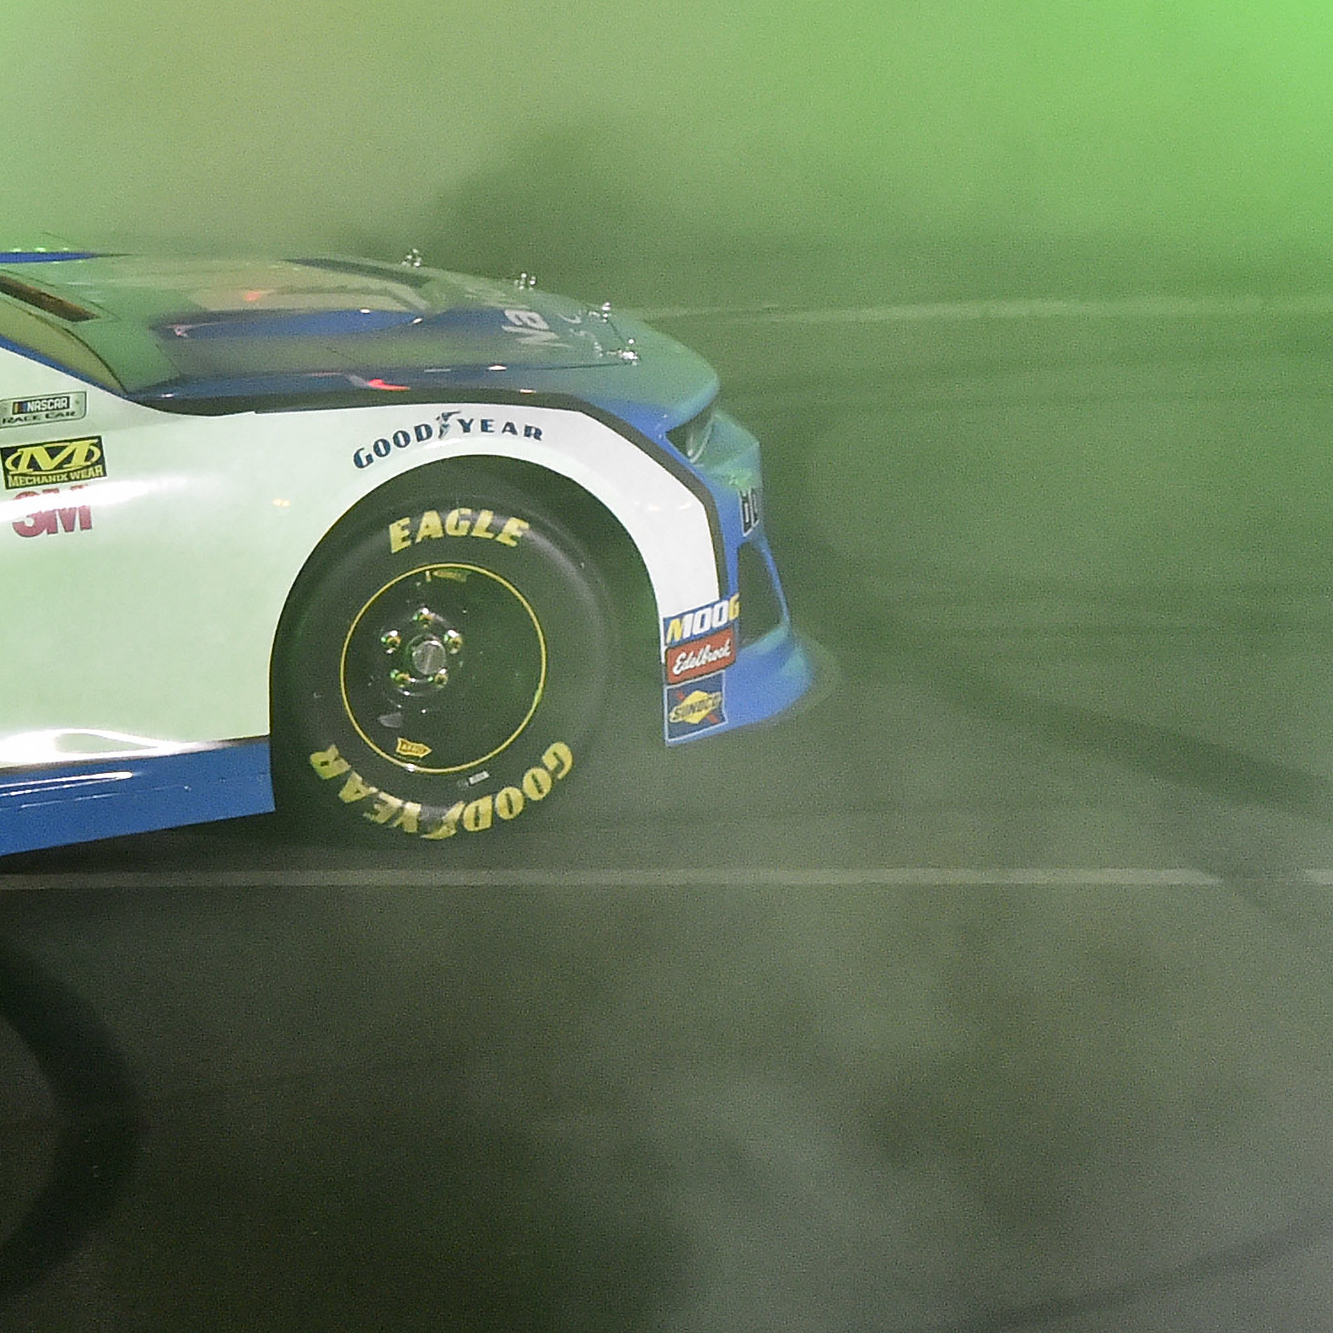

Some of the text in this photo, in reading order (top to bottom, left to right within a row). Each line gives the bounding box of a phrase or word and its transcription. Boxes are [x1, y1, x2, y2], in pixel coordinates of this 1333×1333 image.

[1, 409, 77, 425] RACE CAR
[26, 397, 68, 412] NASCAR
[7, 464, 105, 488] MECHANIX WEAR
[12, 483, 93, 538] 3M
[389, 508, 530, 554] EAGLE
[666, 593, 741, 645] MOOG
[672, 638, 732, 676] Edelbrock
[669, 691, 723, 723] SUNOCO
